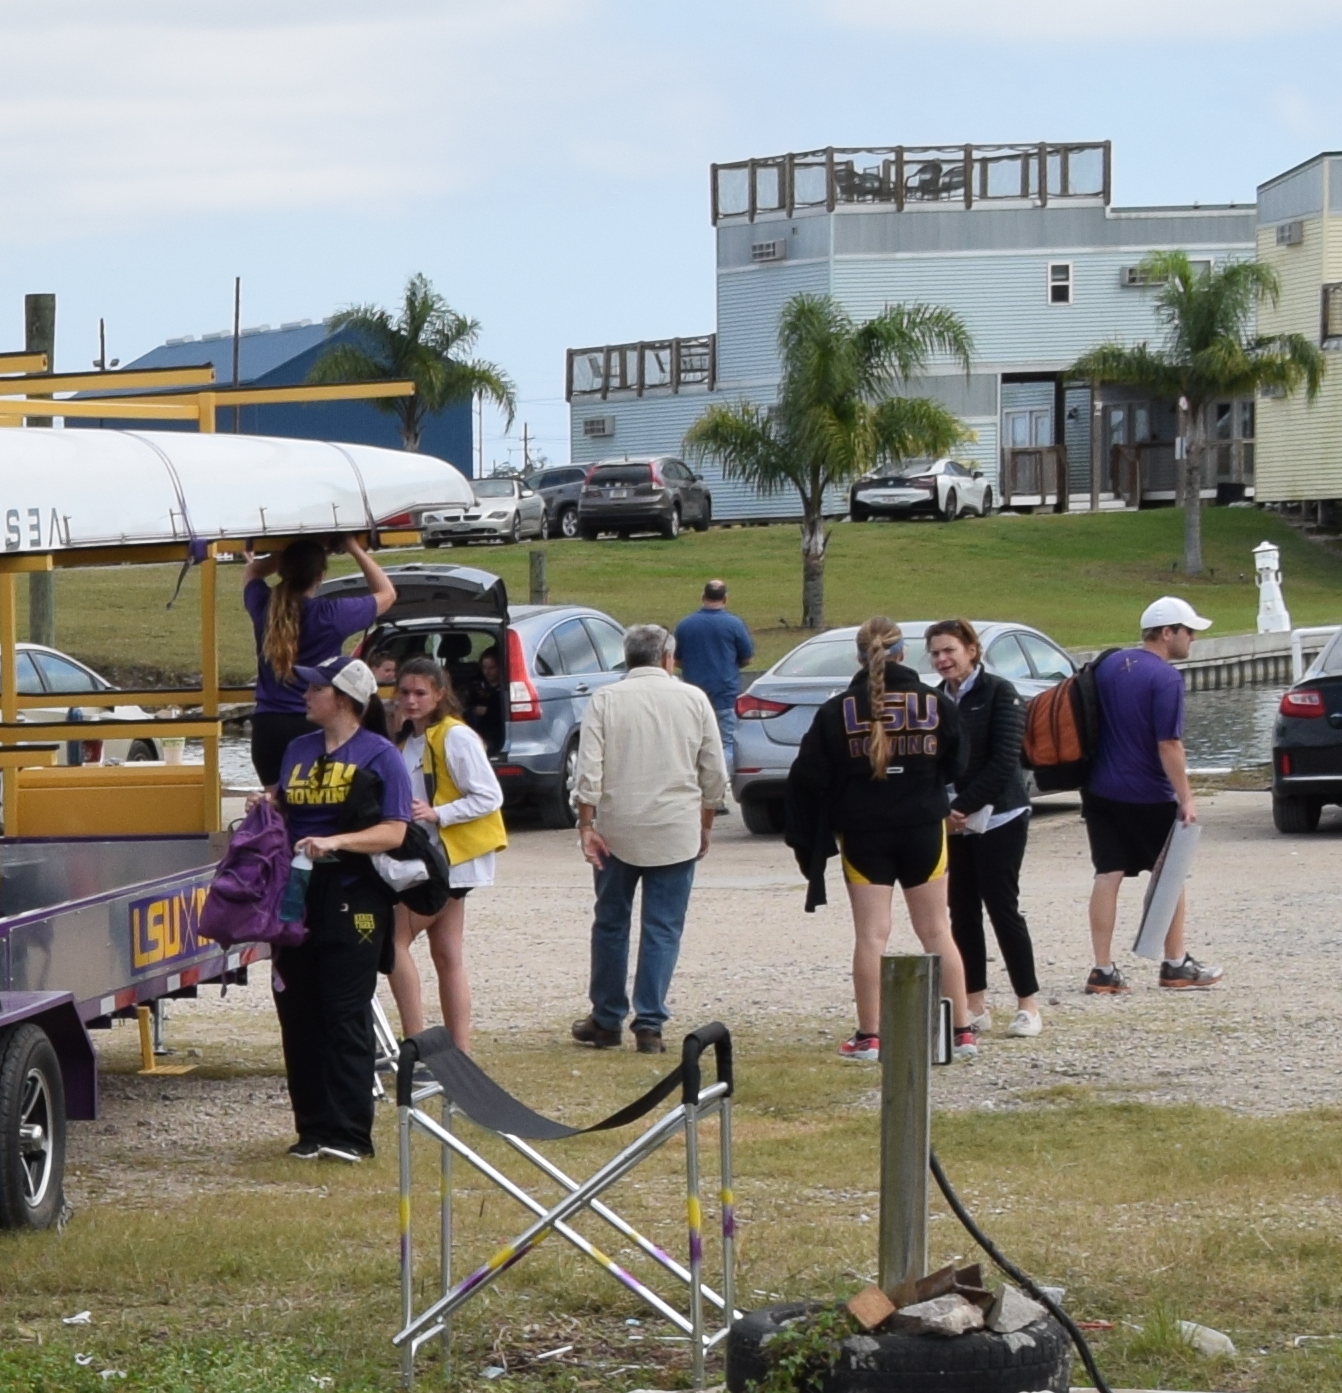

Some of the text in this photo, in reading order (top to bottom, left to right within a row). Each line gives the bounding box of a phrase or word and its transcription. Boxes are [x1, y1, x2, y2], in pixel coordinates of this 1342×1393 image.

[843, 692, 939, 735] LSU
[848, 734, 939, 758] ROING
[285, 786, 351, 805] ROWIN
[132, 895, 181, 969] LSU
